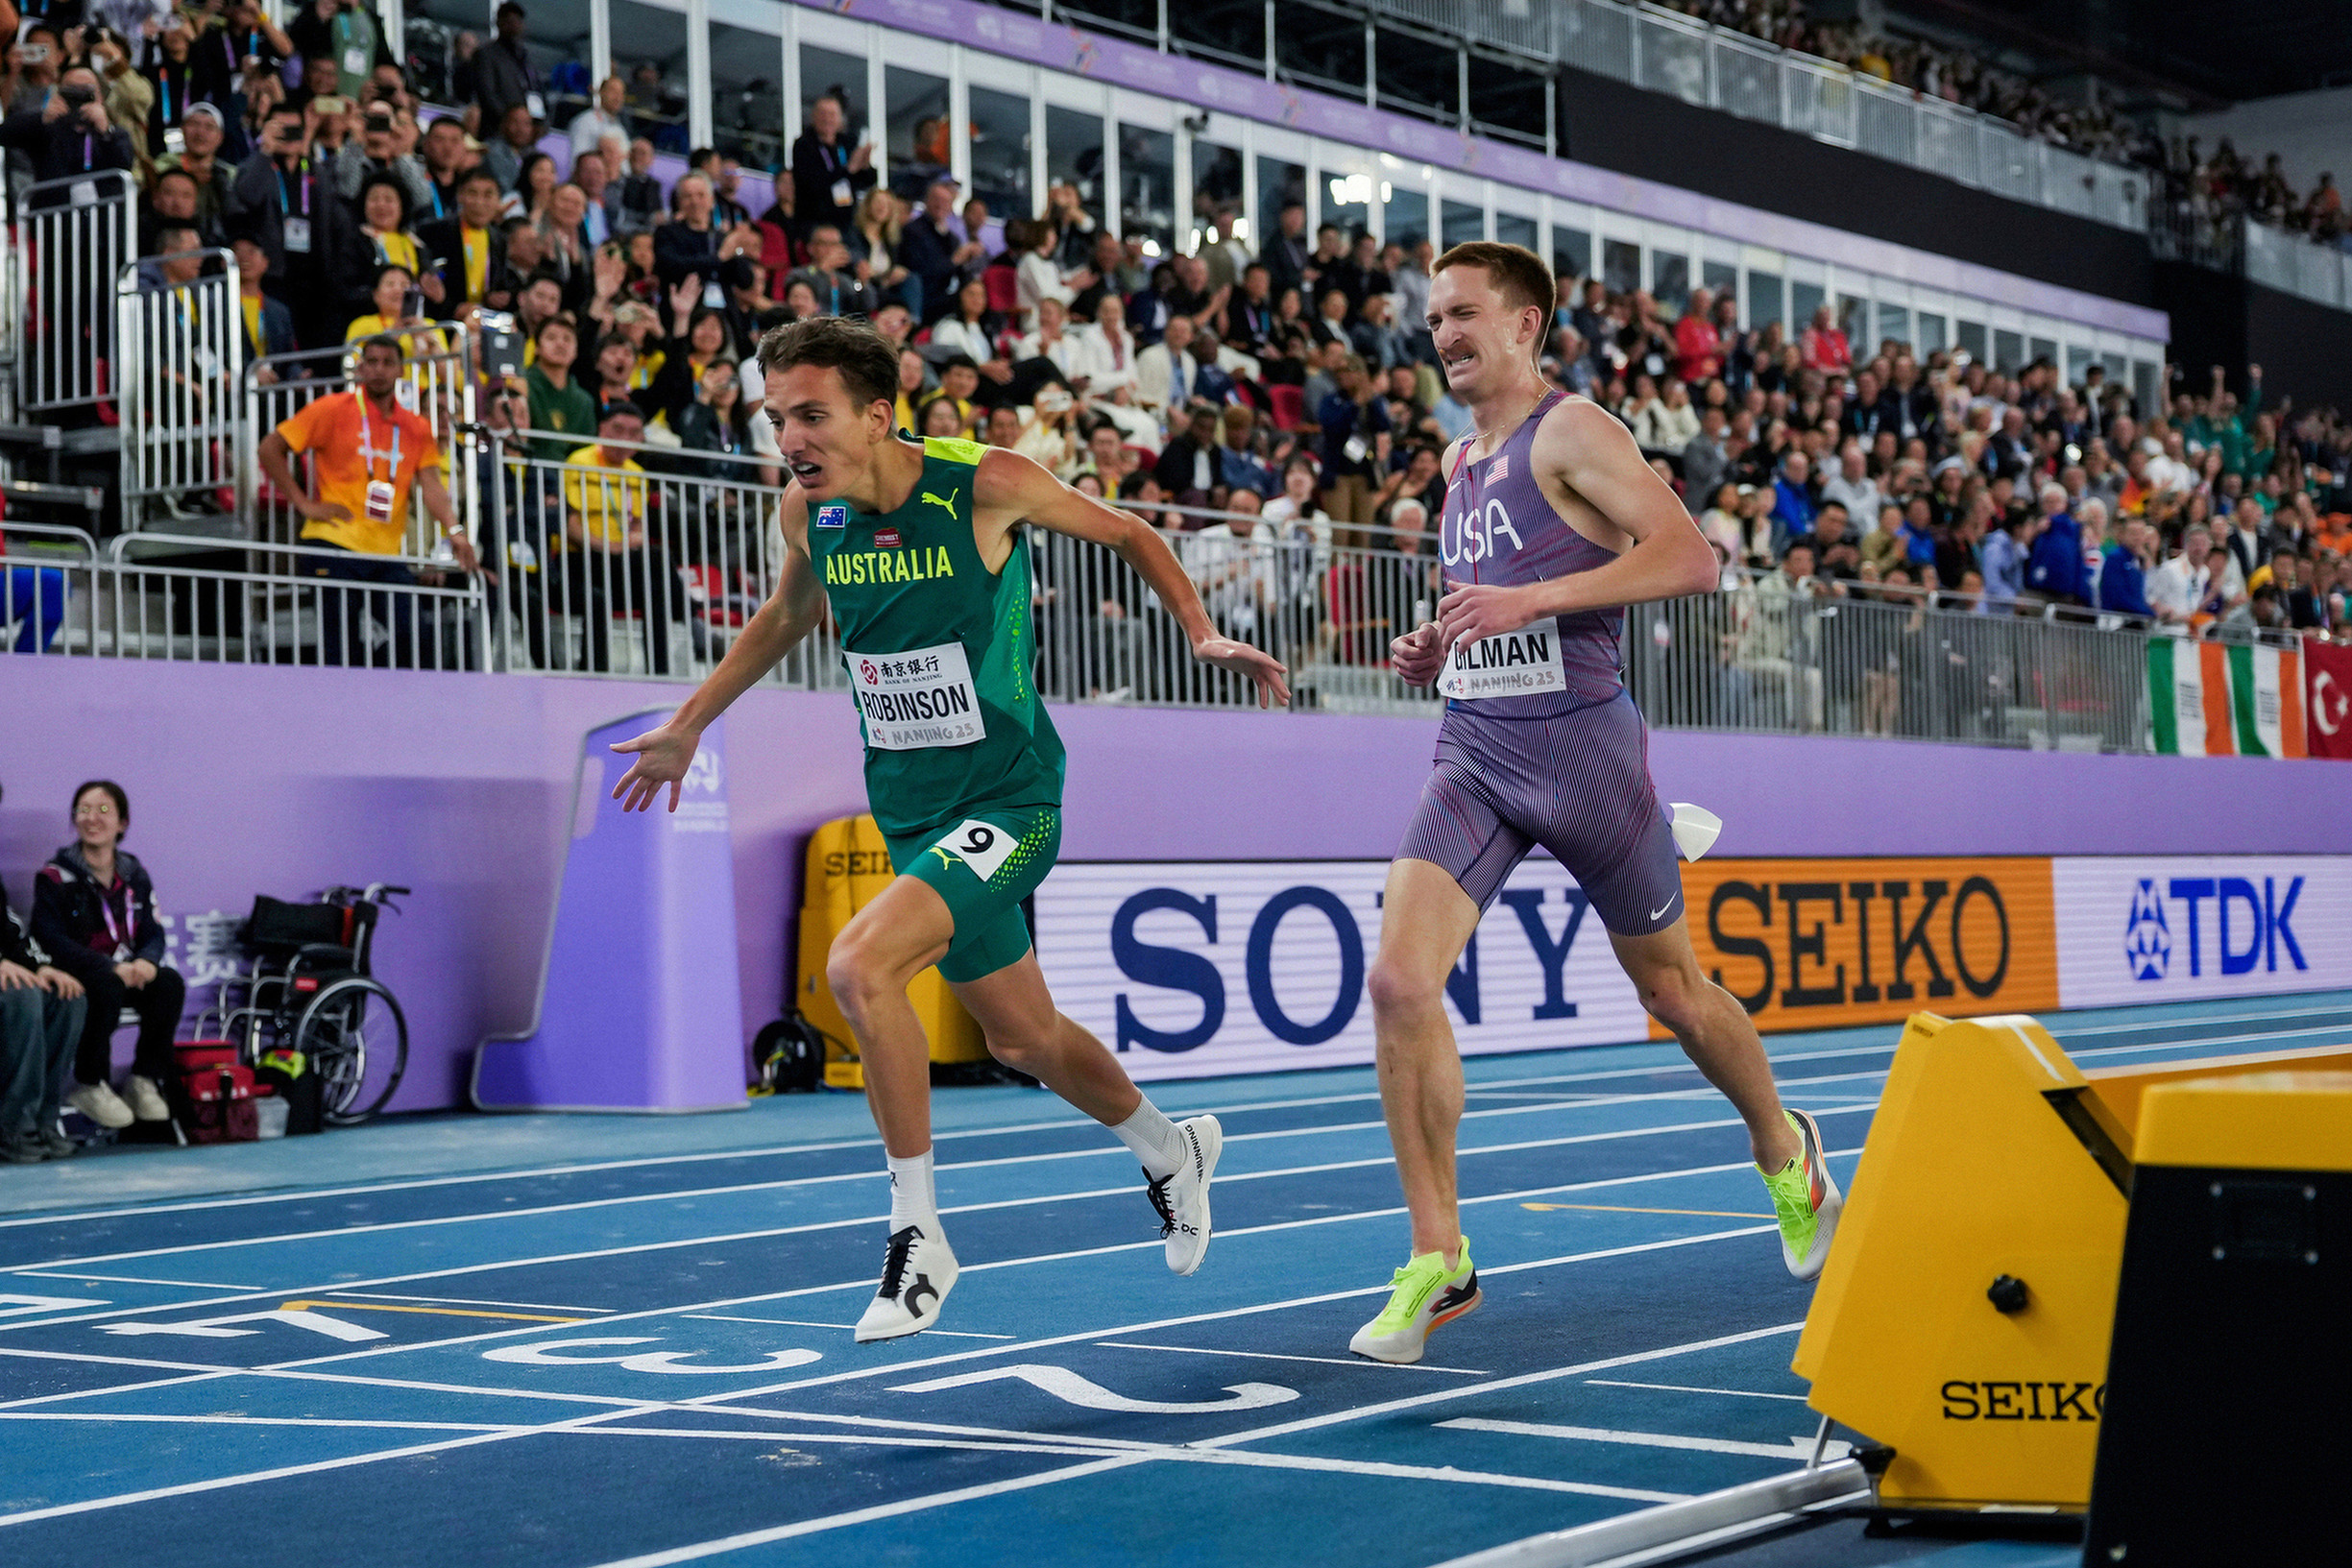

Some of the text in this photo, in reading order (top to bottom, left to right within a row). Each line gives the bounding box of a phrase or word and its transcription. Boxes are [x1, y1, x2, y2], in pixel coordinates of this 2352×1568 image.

[1442, 498, 1523, 567] USA
[826, 545, 954, 585] AUSTRALIA
[881, 655, 939, 678] 南京银行
[912, 673, 942, 683] NANJING
[1470, 672, 1534, 691] NANJING
[861, 683, 970, 722] ROBINSON
[891, 726, 954, 745] NANJING
[959, 827, 995, 854] 9
[825, 851, 890, 878] SEI
[1708, 875, 2009, 1016] SEIKO
[2169, 876, 2309, 977] TDK
[1184, 1123, 1204, 1170] RUNNING
[482, 1337, 822, 1375] 3
[887, 1363, 1300, 1414] 2
